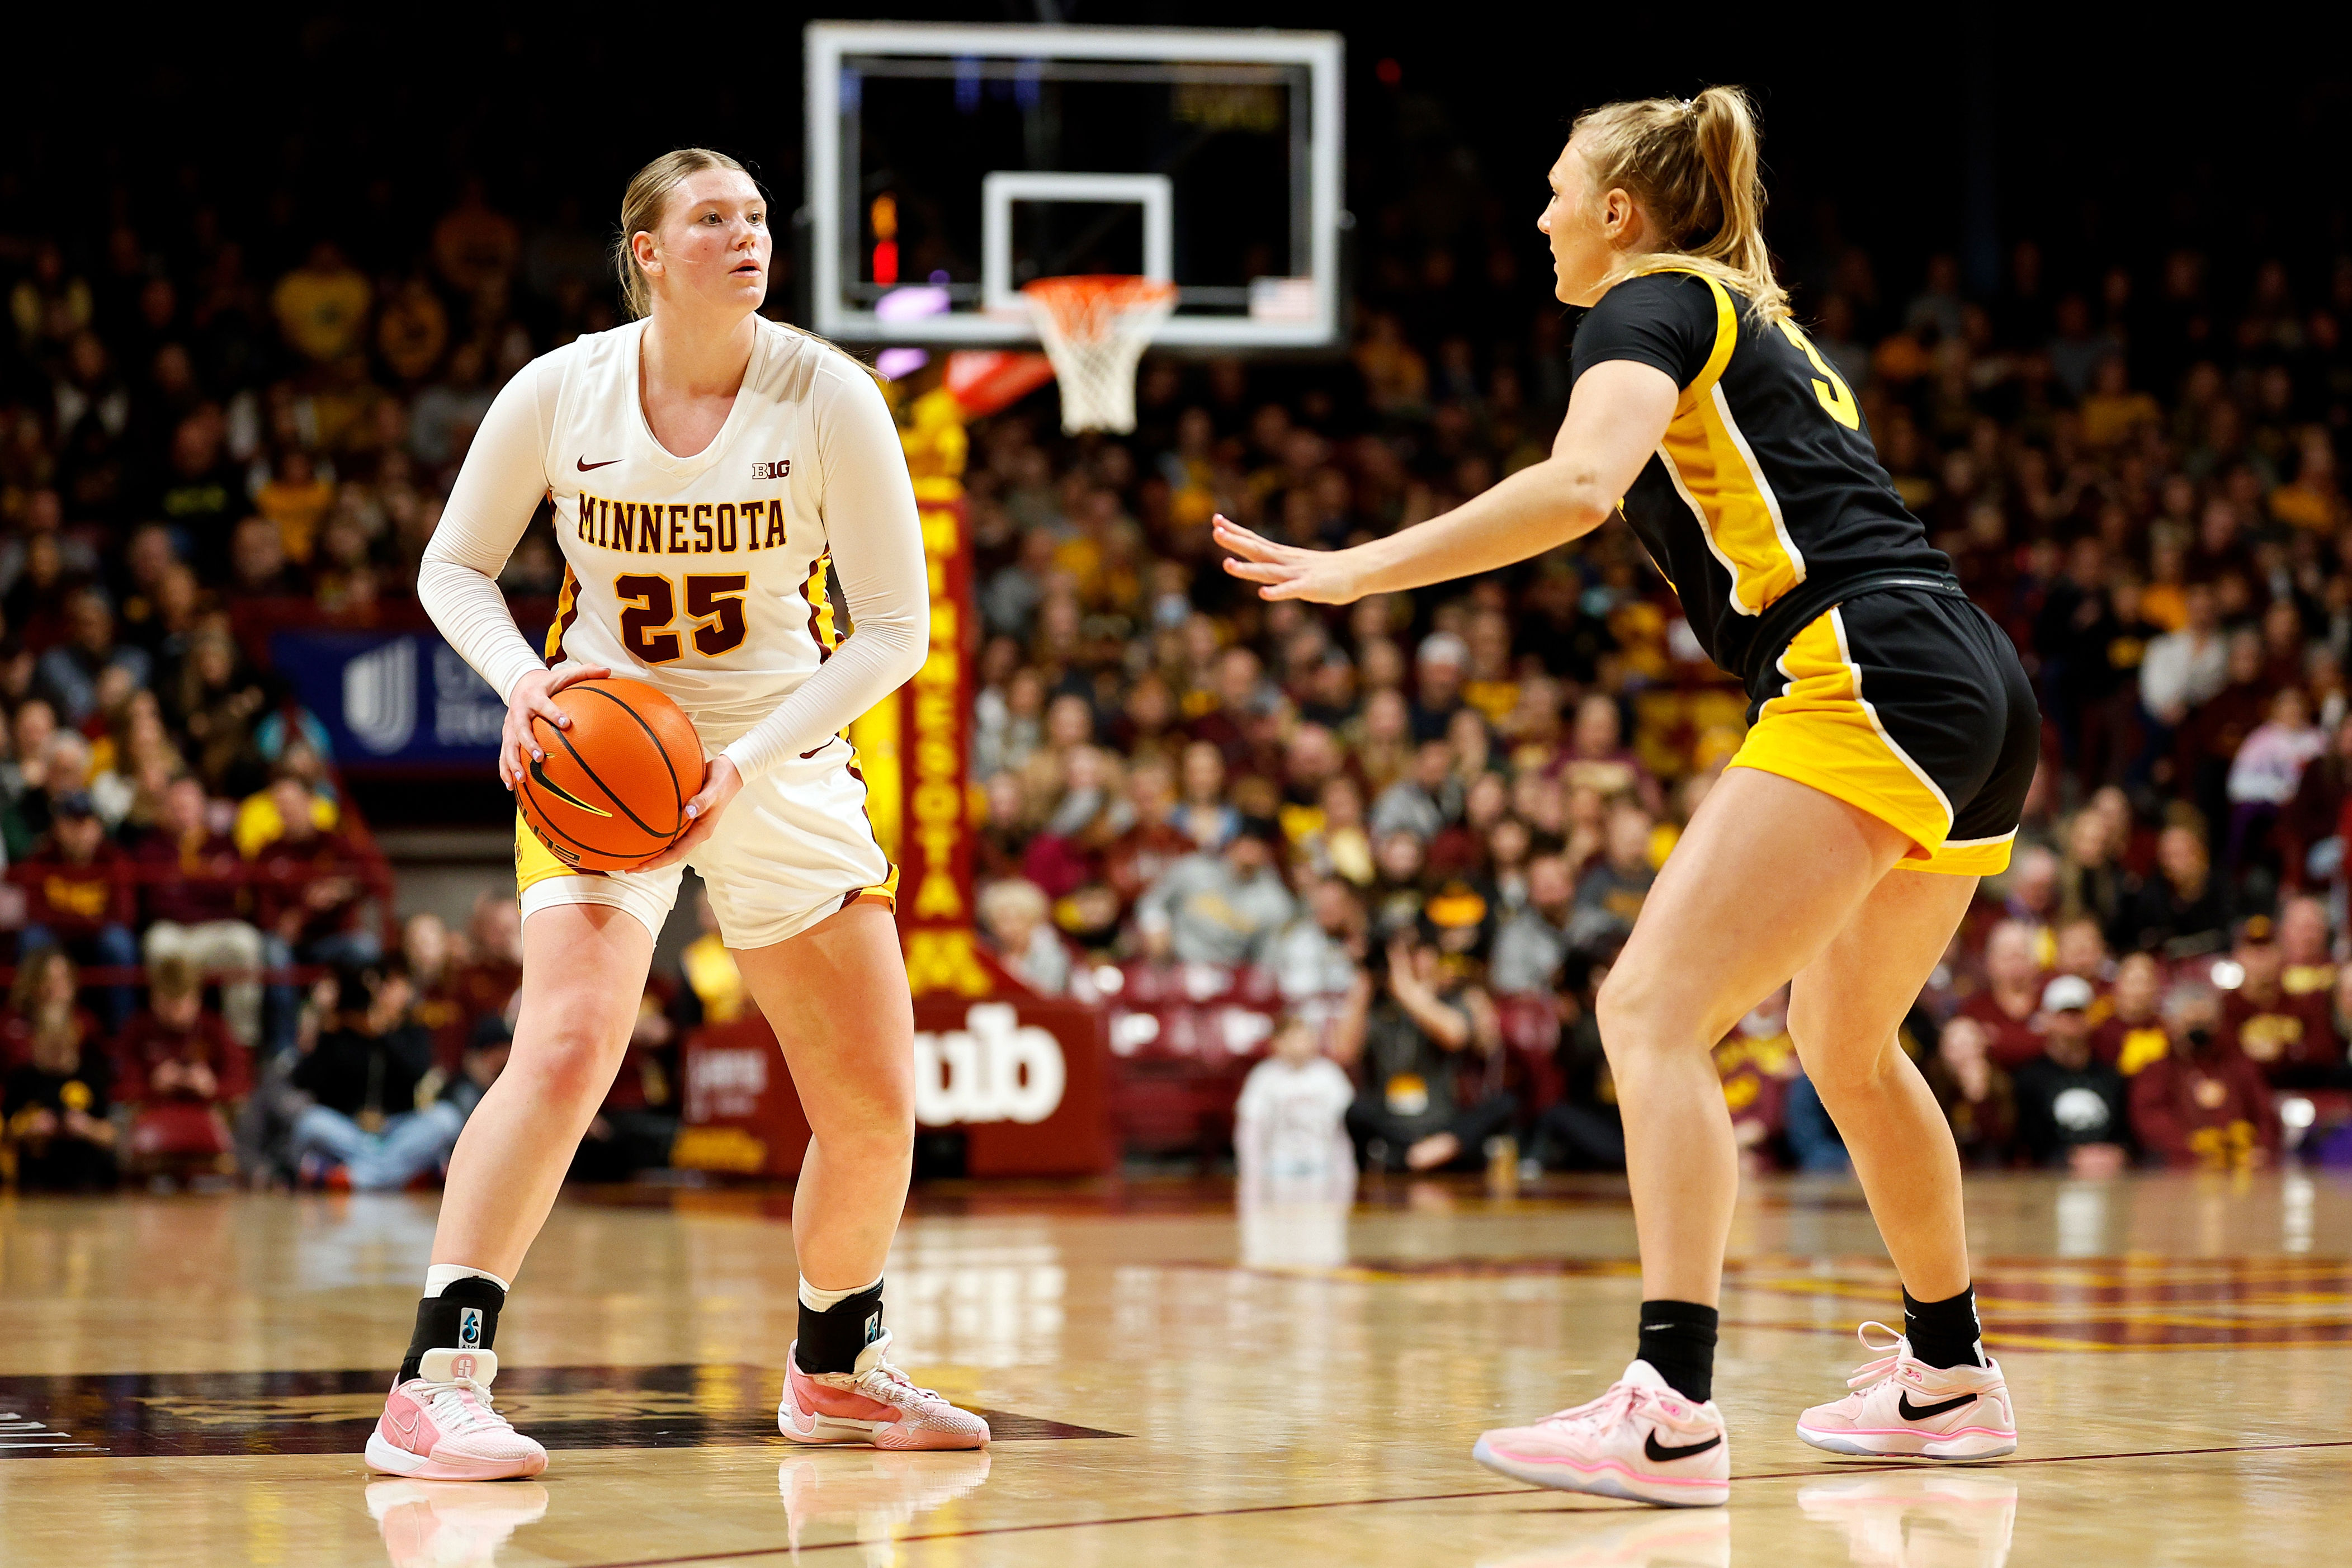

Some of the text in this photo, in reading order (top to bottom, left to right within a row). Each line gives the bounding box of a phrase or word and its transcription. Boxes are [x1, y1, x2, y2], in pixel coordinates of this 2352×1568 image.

[1777, 315, 1860, 431] 3
[578, 490, 787, 555] MINNESOTA
[613, 571, 749, 665] 25
[915, 1002, 1066, 1126] ub
